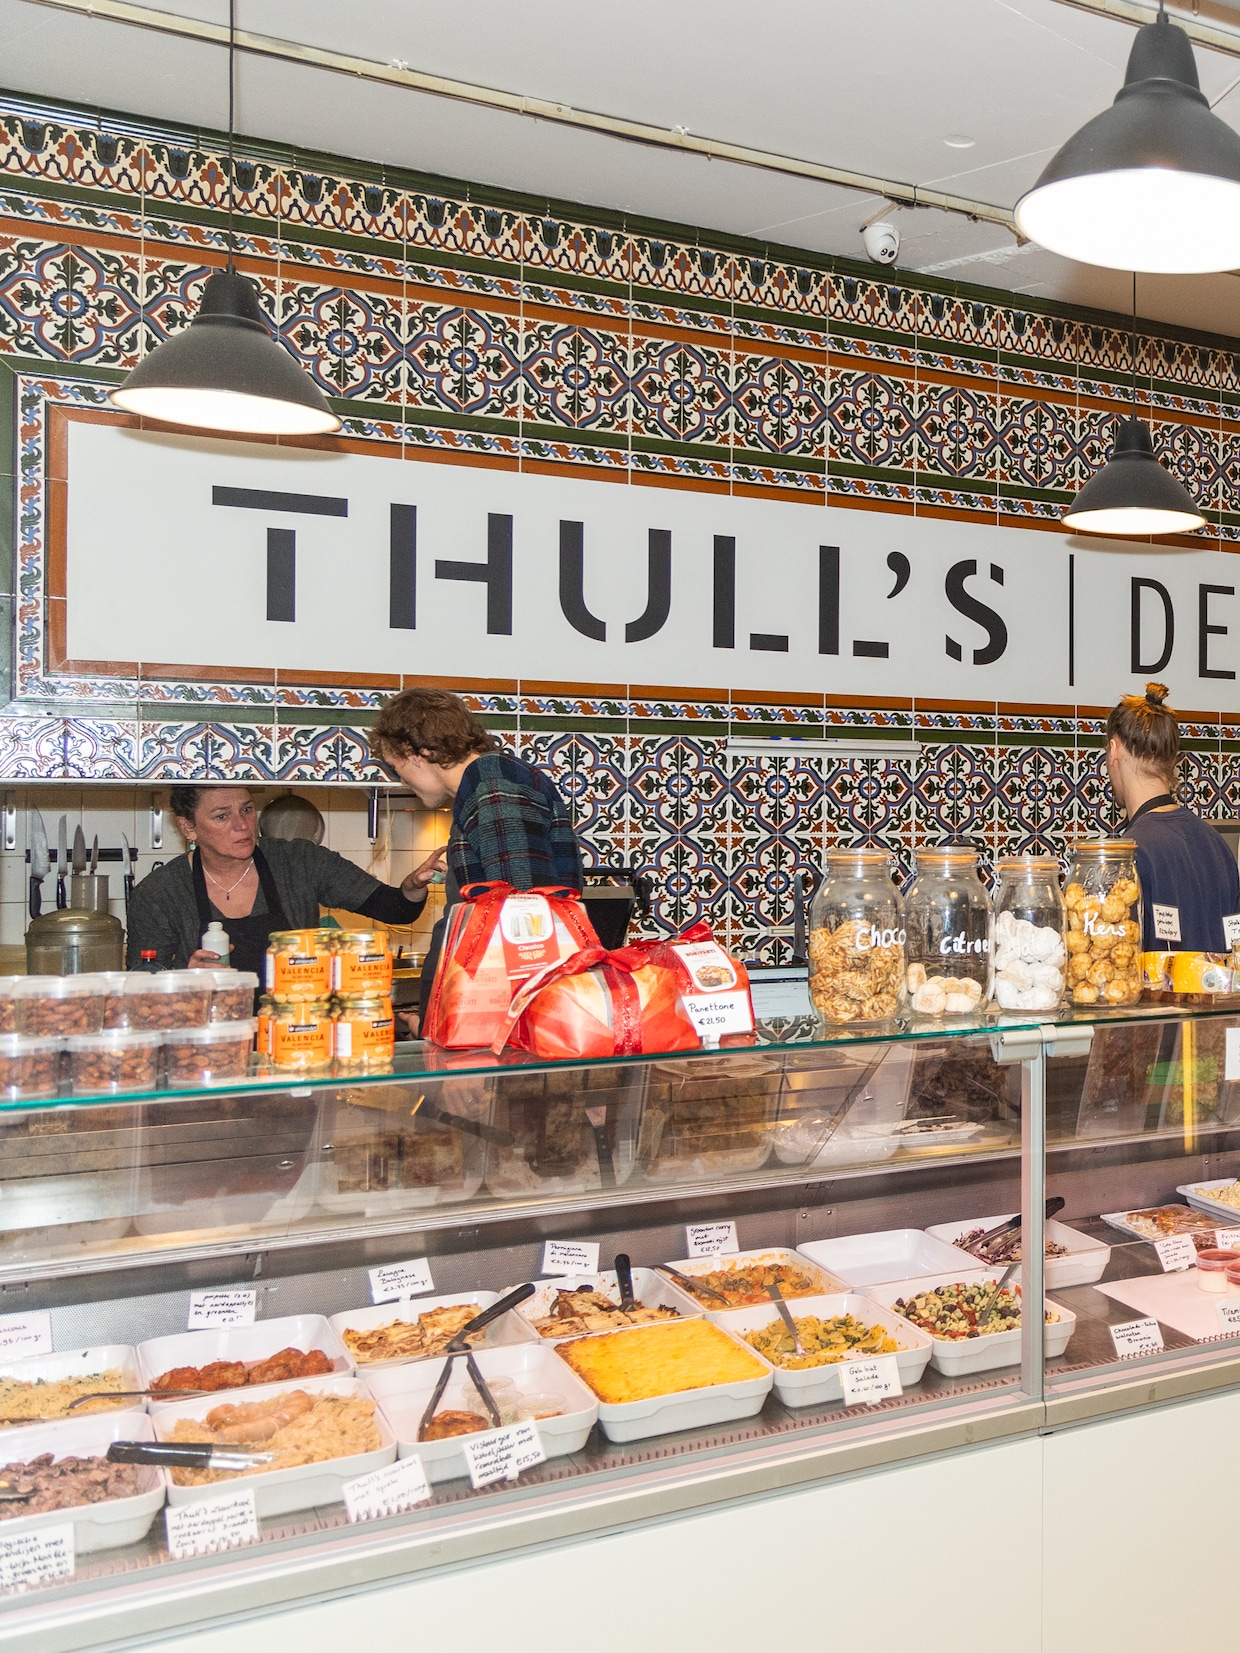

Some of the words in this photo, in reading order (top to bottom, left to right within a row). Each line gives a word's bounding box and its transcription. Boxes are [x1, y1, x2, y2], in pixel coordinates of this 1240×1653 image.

[211, 485, 1008, 665] THULL’S
[855, 925, 906, 951] Choco
[518, 946, 545, 955] Classico
[281, 967, 325, 975] VALENCIA
[350, 964, 390, 972] VALENCIA
[688, 1002, 735, 1013] Panettone
[281, 1034, 325, 1042] VALENCIA
